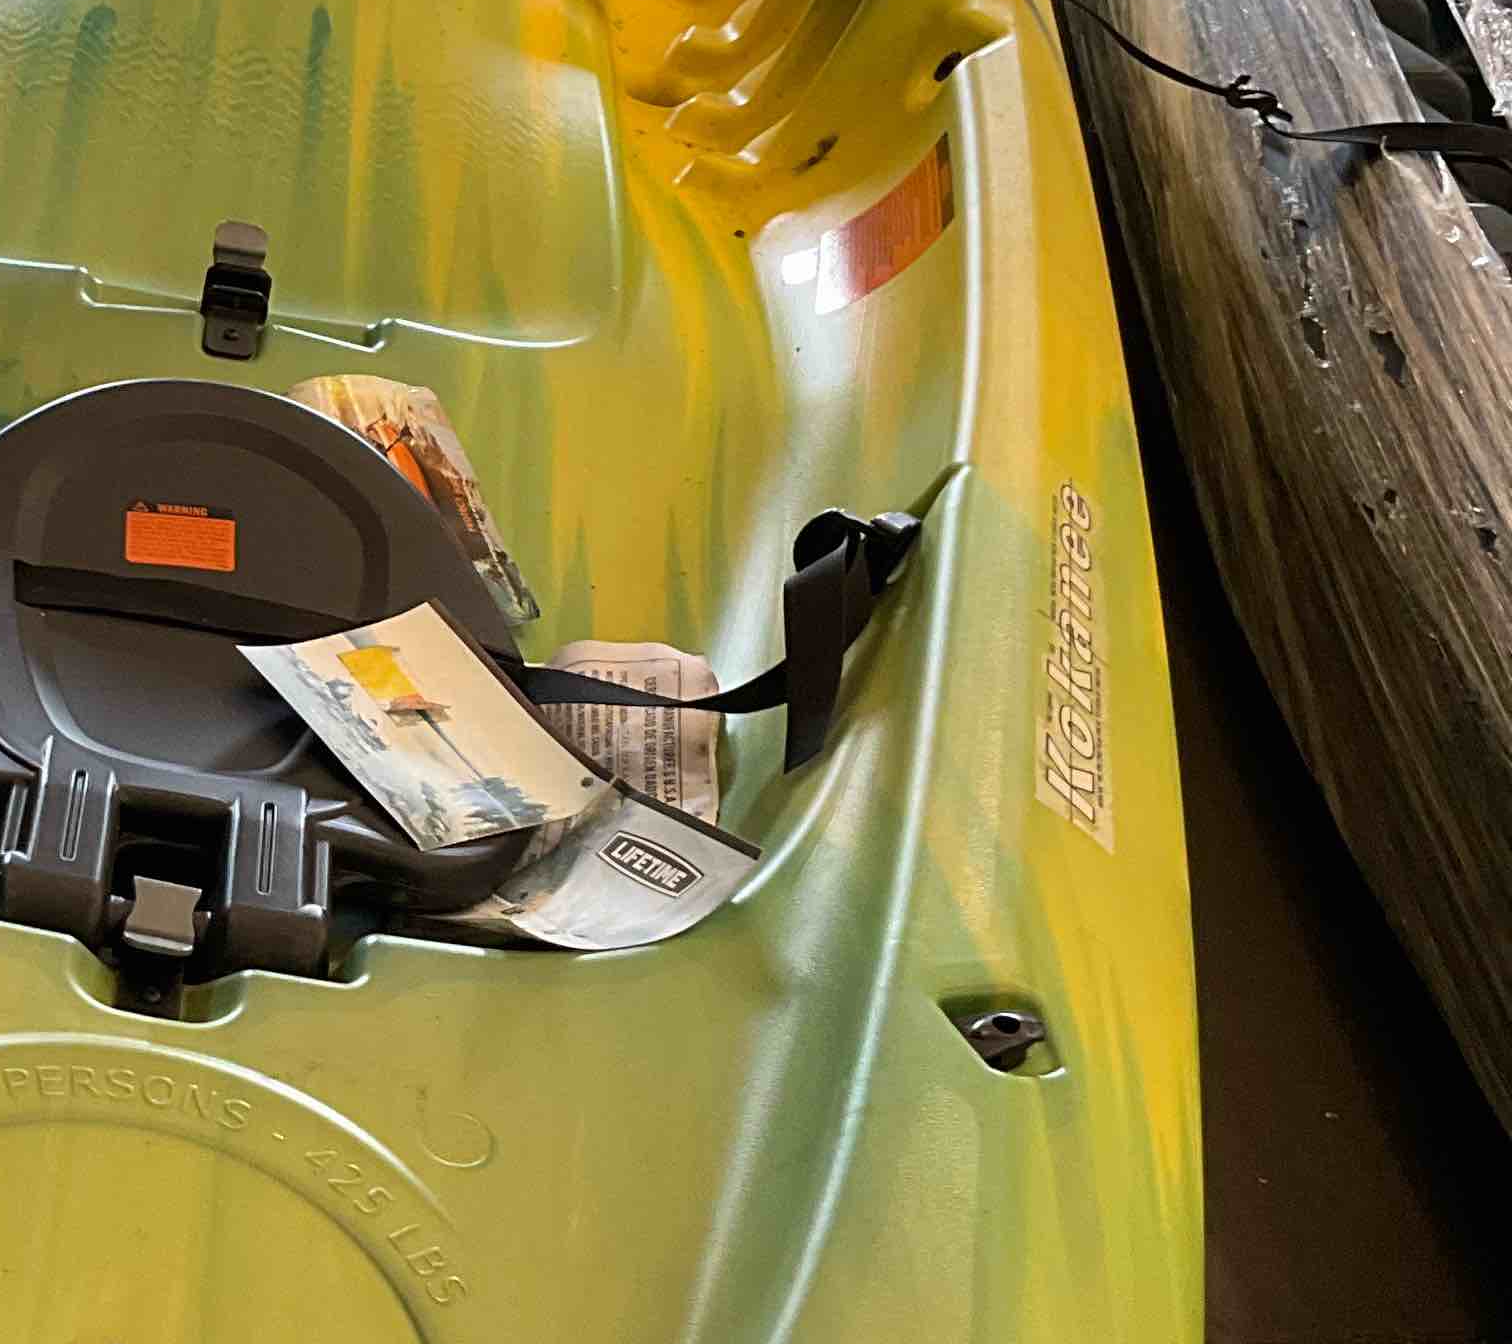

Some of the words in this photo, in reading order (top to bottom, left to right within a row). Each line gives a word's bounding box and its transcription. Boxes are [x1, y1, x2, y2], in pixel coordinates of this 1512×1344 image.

[1045, 484, 1096, 824] Kokanee
[611, 841, 687, 889] LIFETIME
[3, 1064, 252, 1130] PERSONS
[304, 1149, 396, 1215] 425
[387, 1223, 468, 1305] LBS
